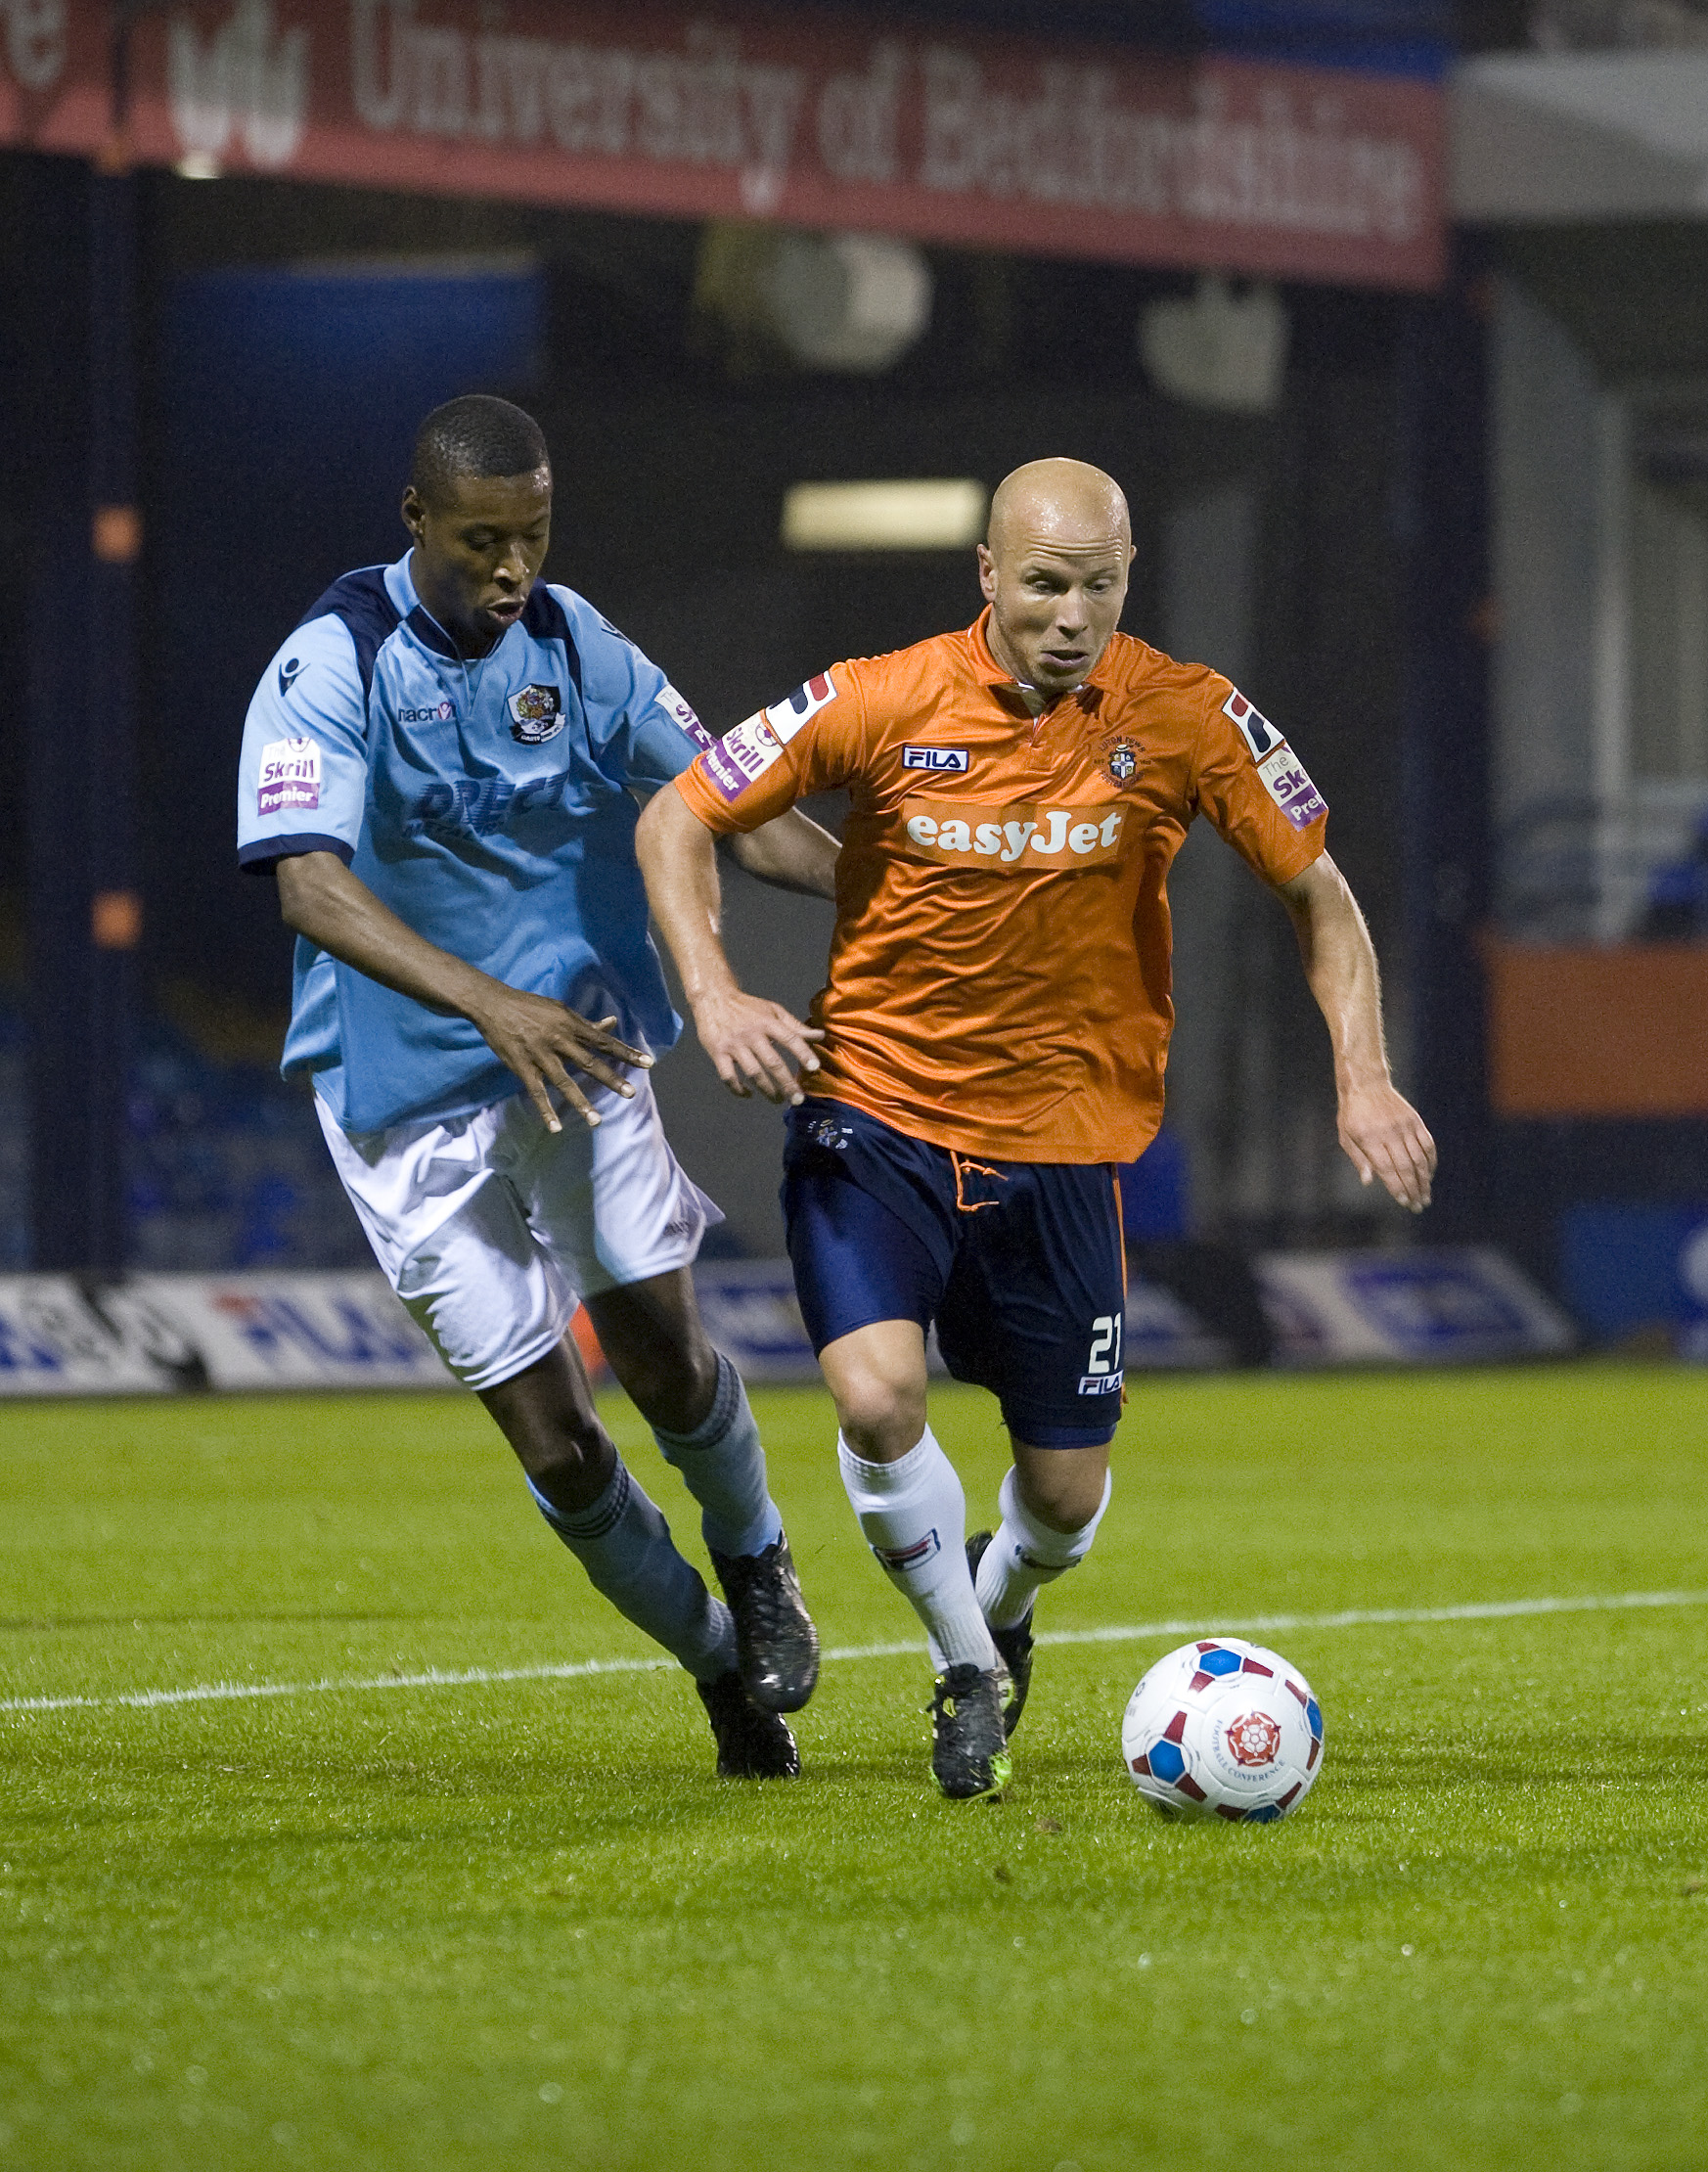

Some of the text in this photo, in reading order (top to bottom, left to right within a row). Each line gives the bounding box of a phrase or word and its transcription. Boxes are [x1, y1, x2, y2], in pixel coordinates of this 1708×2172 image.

[350, 0, 800, 213] University
[815, 39, 901, 182] of
[726, 727, 765, 774] Skrill
[908, 750, 962, 768] FILA
[263, 759, 314, 782] Skrill
[1262, 755, 1289, 777] The
[260, 786, 314, 809] Premier
[906, 810, 1122, 862] easyJet
[1089, 1312, 1122, 1374] 21
[1082, 1375, 1120, 1394] FILA
[1228, 1760, 1285, 1782] CONFERENCE
